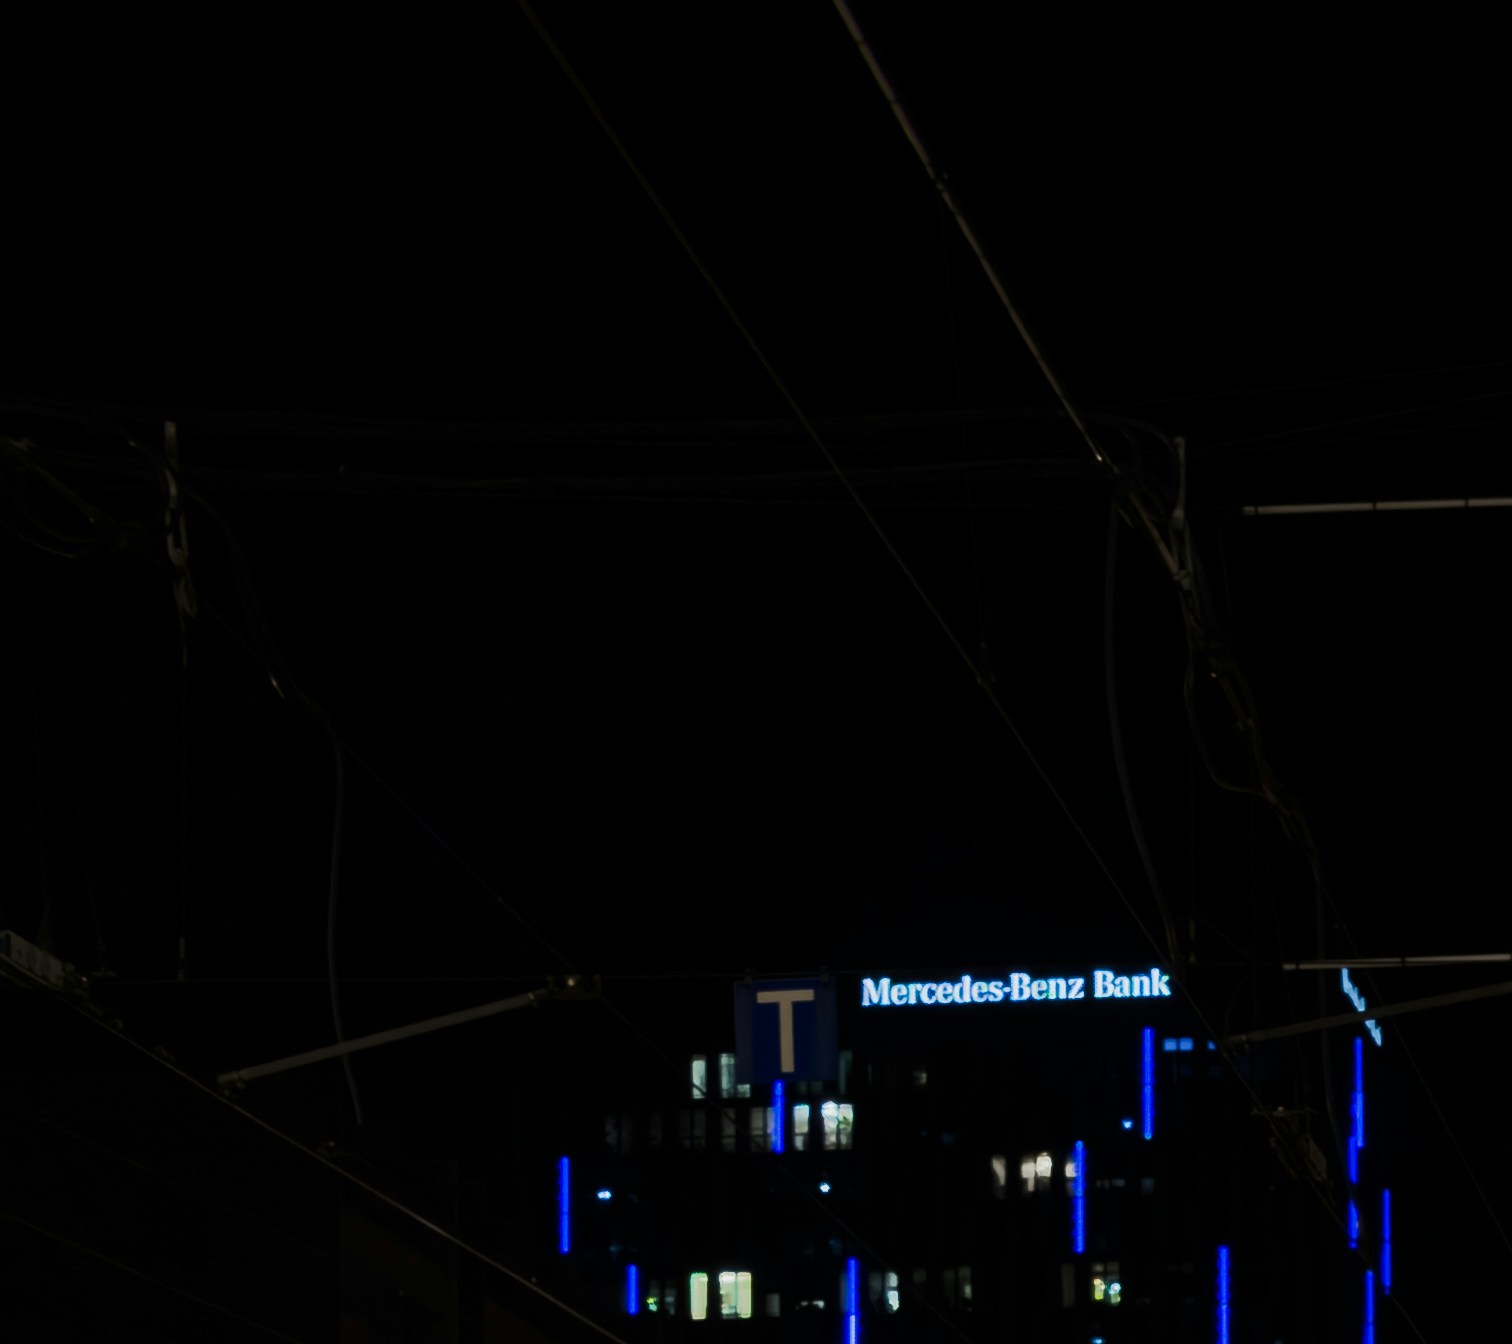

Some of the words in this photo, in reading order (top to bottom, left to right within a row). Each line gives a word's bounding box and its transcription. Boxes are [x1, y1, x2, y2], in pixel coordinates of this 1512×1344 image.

[861, 972, 1085, 1006] Mercedes-Benz
[1093, 968, 1171, 999] Bank
[757, 988, 814, 1073] T
